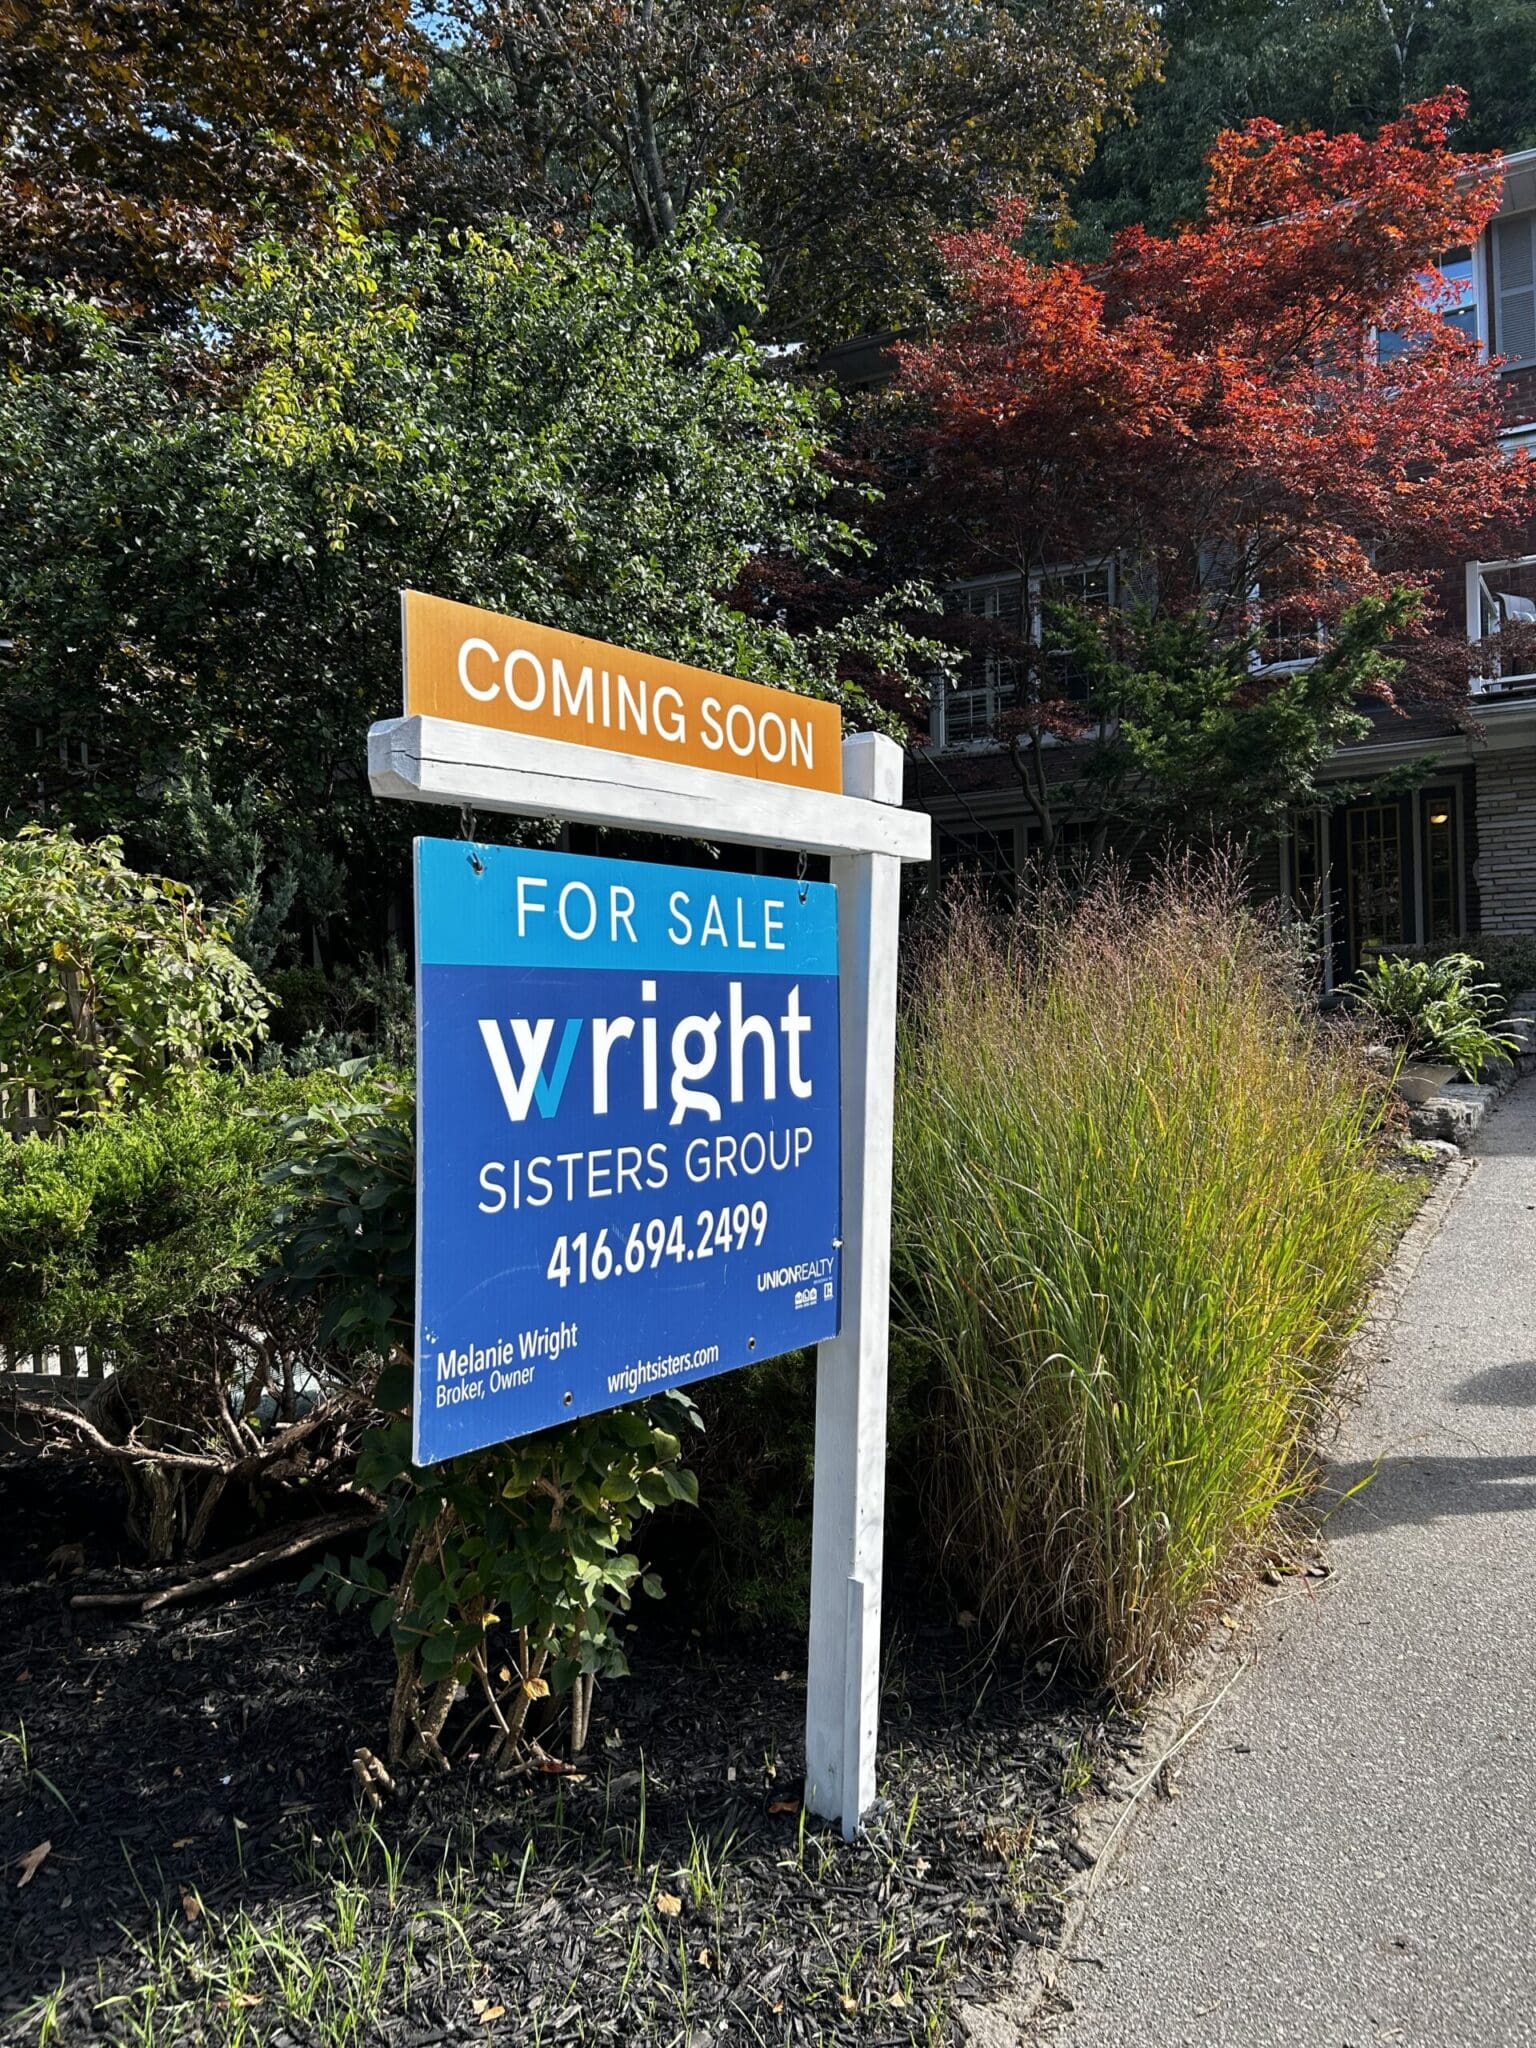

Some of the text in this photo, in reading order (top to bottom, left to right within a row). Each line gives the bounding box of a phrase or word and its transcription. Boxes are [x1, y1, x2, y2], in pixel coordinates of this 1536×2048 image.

[457, 638, 814, 769] COMING SOON
[516, 876, 786, 951] FOR SALE
[478, 980, 812, 1126] wright
[478, 1127, 813, 1214] SISTERS GROUP
[547, 1201, 768, 1288] 416.694.2499
[436, 1365, 535, 1409] Broker, Owner
[437, 1322, 578, 1381] Melanie Wright
[607, 1344, 720, 1394] wrightsisters.com
